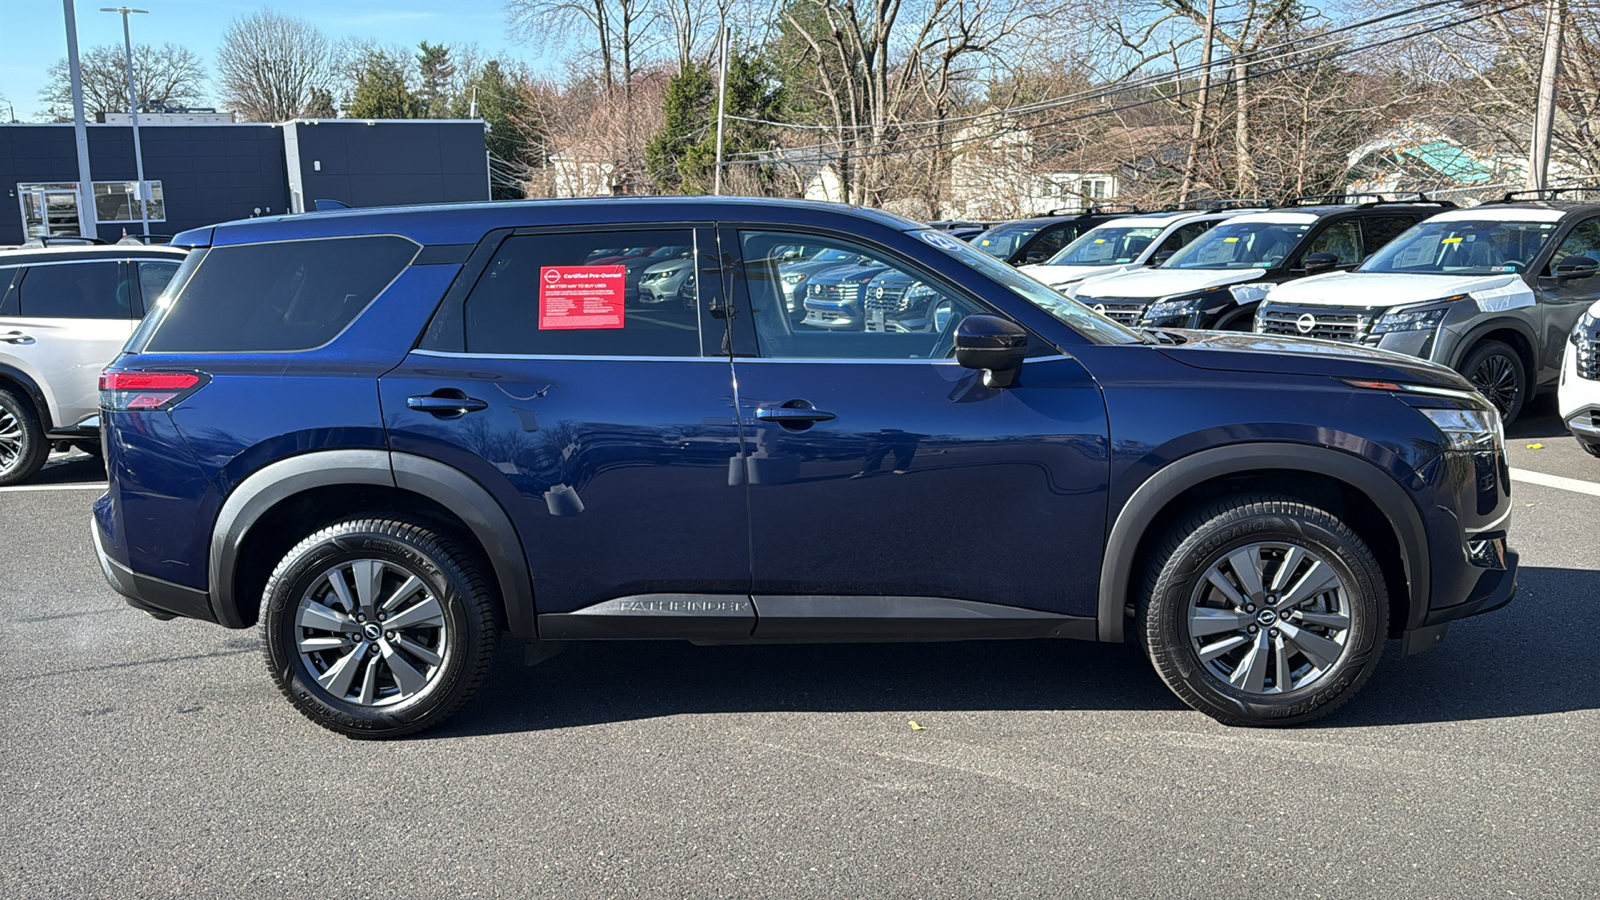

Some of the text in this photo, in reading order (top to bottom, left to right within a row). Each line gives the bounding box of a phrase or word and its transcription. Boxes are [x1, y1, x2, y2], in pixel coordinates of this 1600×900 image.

[362, 539, 442, 577] ASSURANCE
[1191, 519, 1271, 565] ASSURANCE
[619, 600, 748, 612] PATHFINDER
[1270, 676, 1350, 717] GOODYEAR
